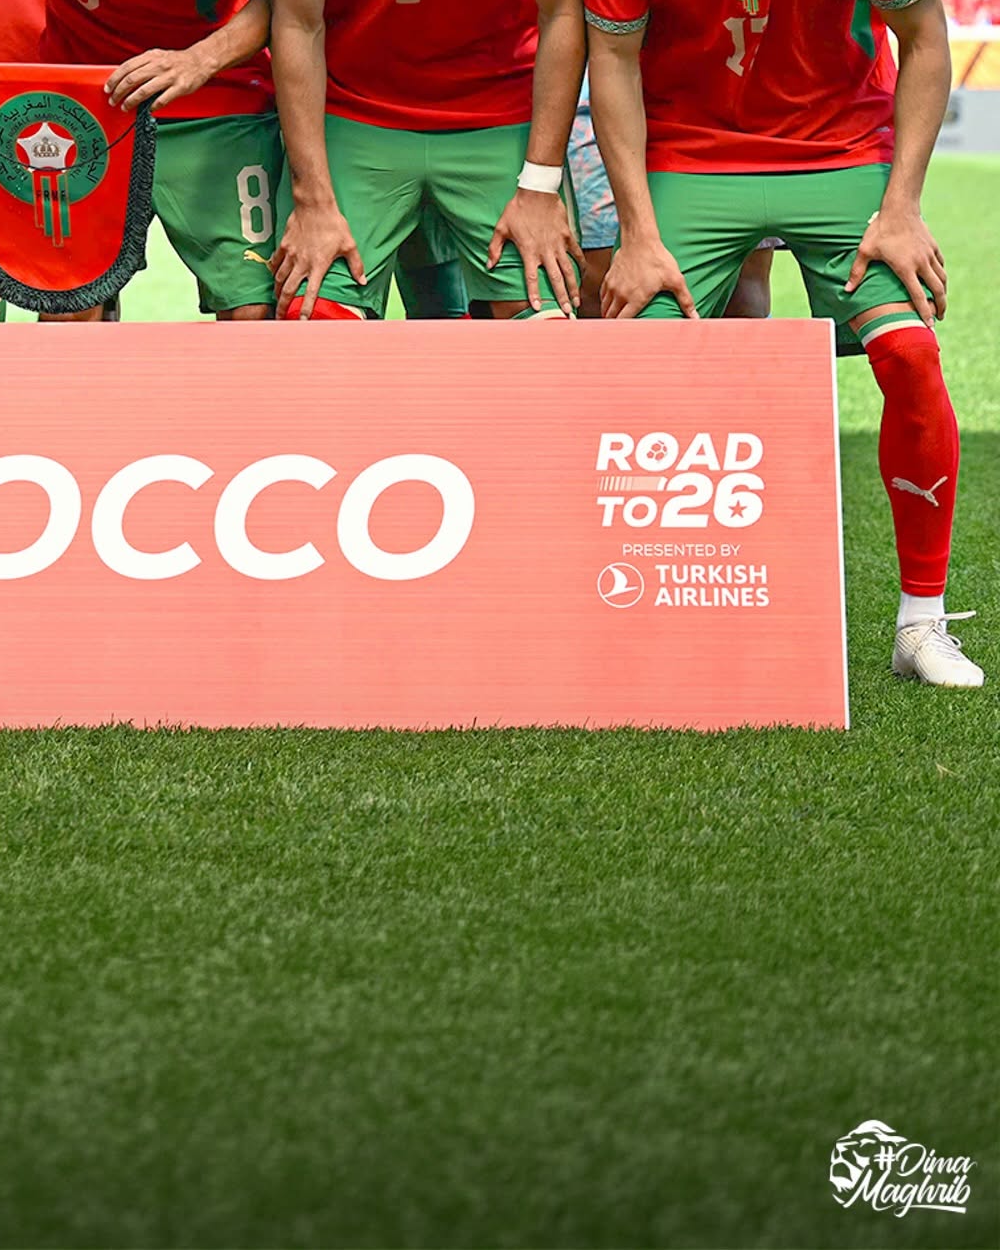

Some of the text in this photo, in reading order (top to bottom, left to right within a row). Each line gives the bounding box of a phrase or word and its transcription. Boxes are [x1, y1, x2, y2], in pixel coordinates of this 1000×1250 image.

[236, 164, 273, 244] 8
[595, 431, 764, 472] ROAD
[597, 472, 766, 528] TO 26
[622, 543, 741, 557] PRESENTED BY
[655, 564, 767, 585] TURKISH
[654, 587, 770, 607] AIRLINES
